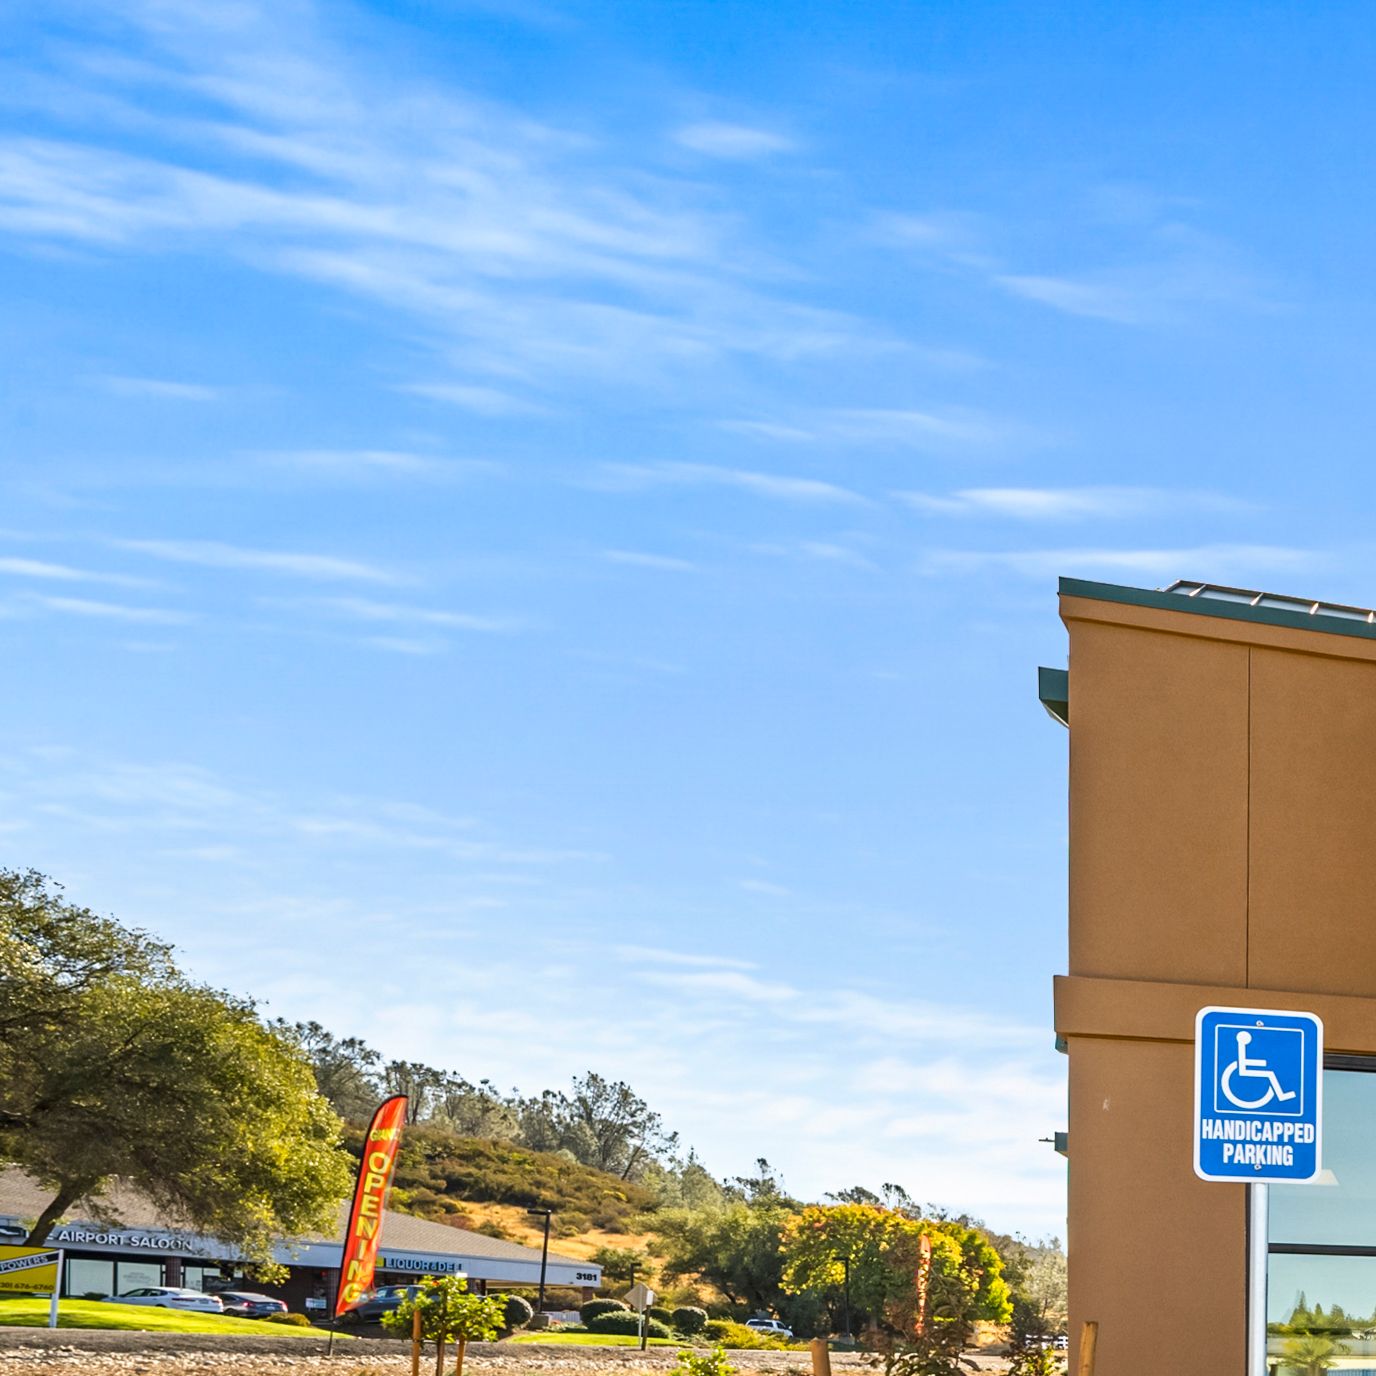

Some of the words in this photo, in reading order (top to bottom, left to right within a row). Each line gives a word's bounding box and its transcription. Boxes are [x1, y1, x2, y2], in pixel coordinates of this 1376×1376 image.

[1201, 1118, 1315, 1144] HANDICAPPED
[1223, 1143, 1294, 1167] PARKING
[58, 1230, 126, 1246] AIRPORT
[129, 1235, 193, 1252] SALOON
[1, 1255, 49, 1271] POWERS
[384, 1257, 430, 1271] LIQUOR
[576, 1272, 598, 1282] 3181
